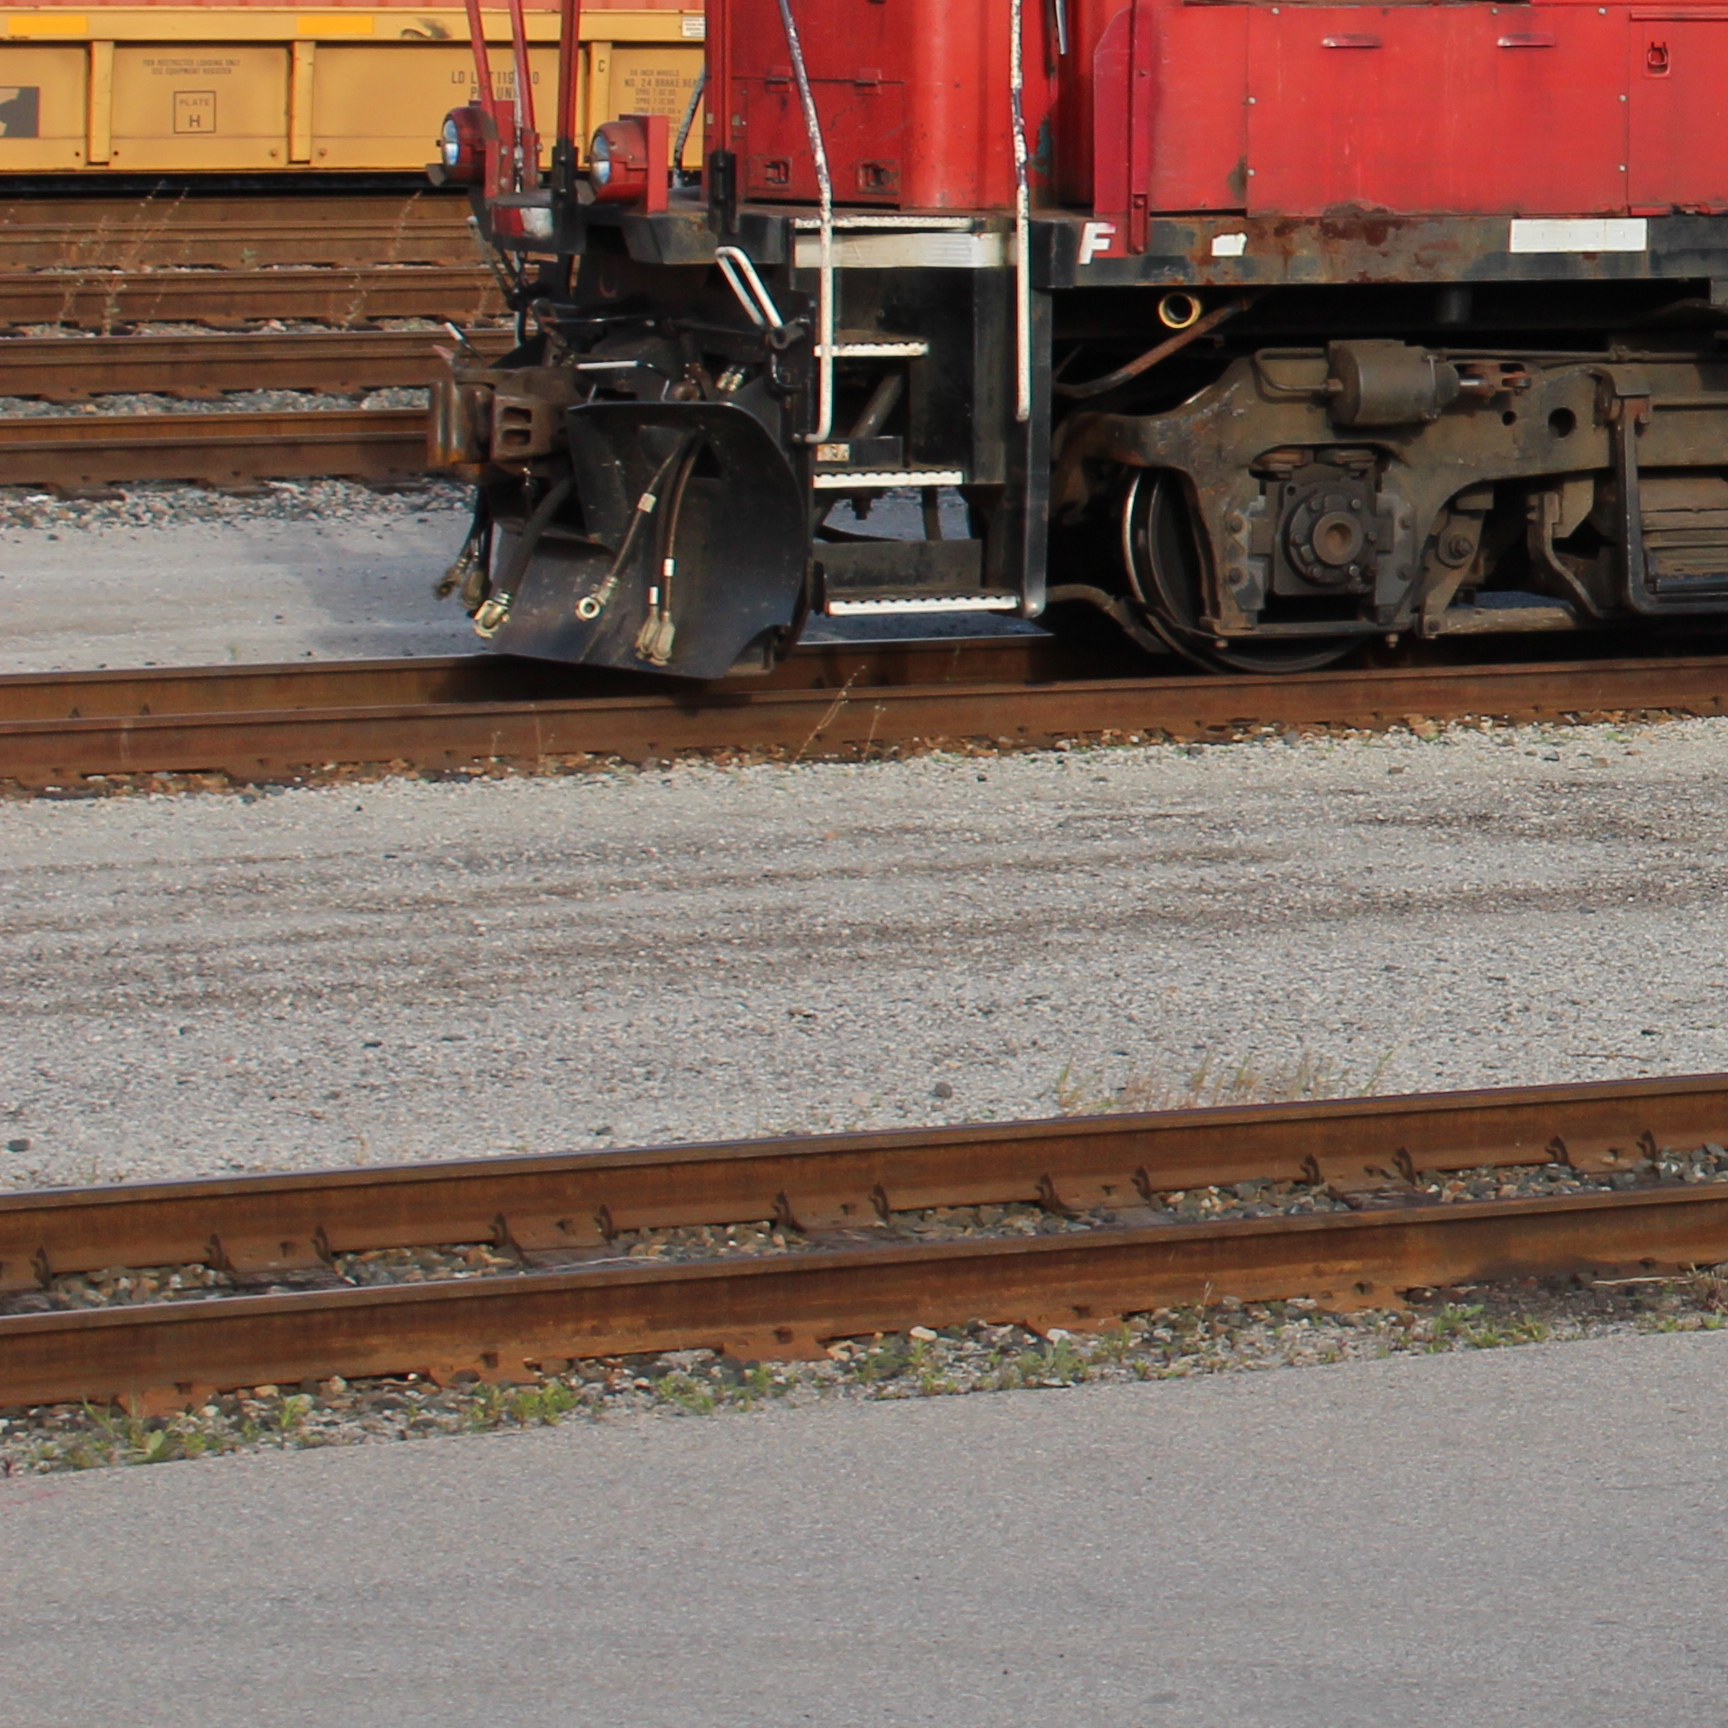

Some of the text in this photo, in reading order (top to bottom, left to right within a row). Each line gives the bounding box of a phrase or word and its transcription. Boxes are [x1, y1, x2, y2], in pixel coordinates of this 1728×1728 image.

[598, 59, 606, 73] C
[452, 71, 464, 84] LD
[179, 98, 209, 106] PLATE
[189, 114, 200, 127] H
[1079, 221, 1116, 265] F
